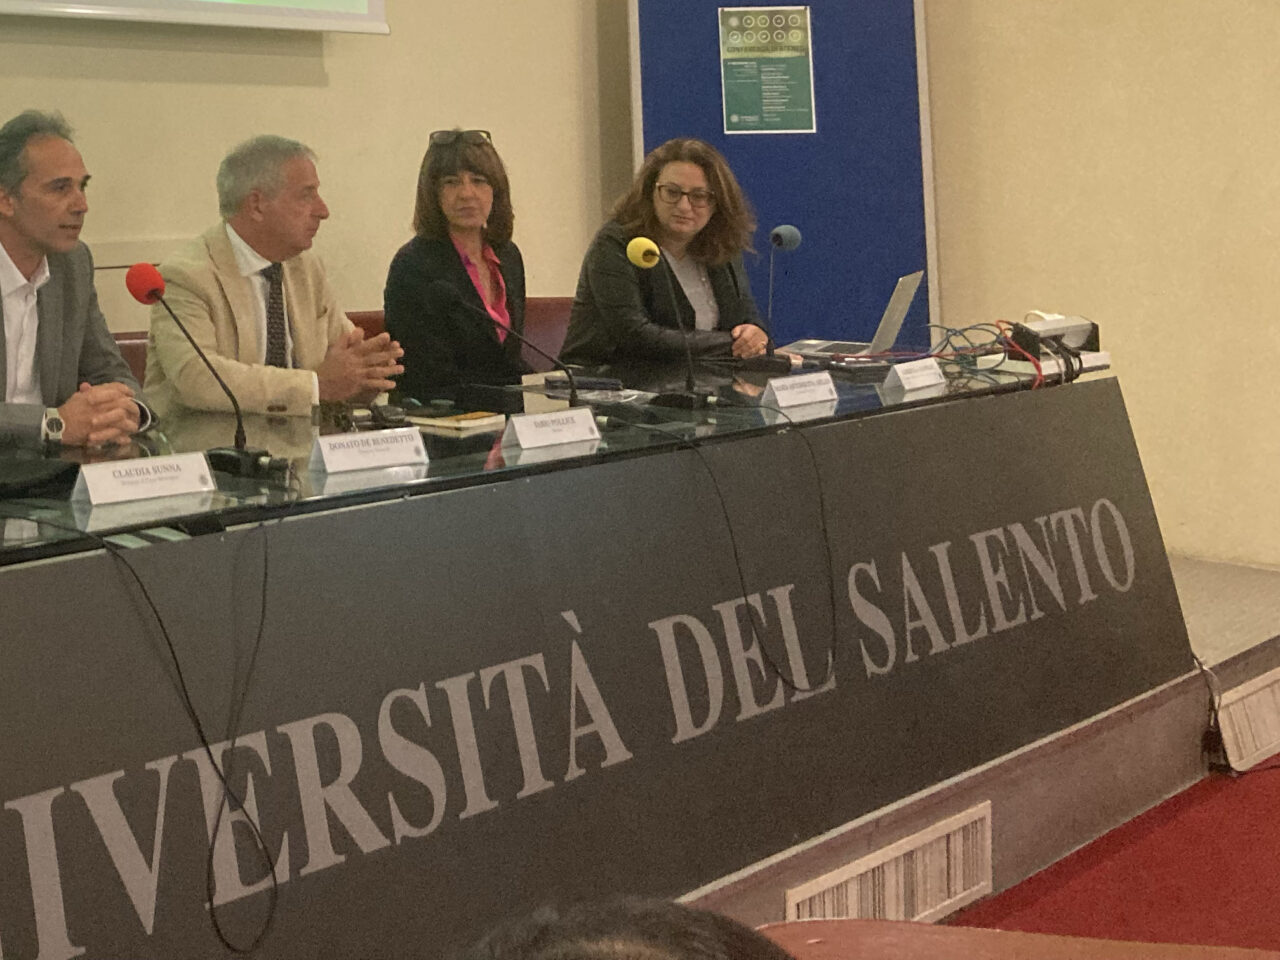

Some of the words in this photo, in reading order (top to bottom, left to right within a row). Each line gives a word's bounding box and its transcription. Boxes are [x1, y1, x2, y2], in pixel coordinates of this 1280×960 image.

[112, 467, 151, 479] CLAUDIA
[648, 584, 836, 744] DEL
[847, 498, 1134, 679] SALENTO
